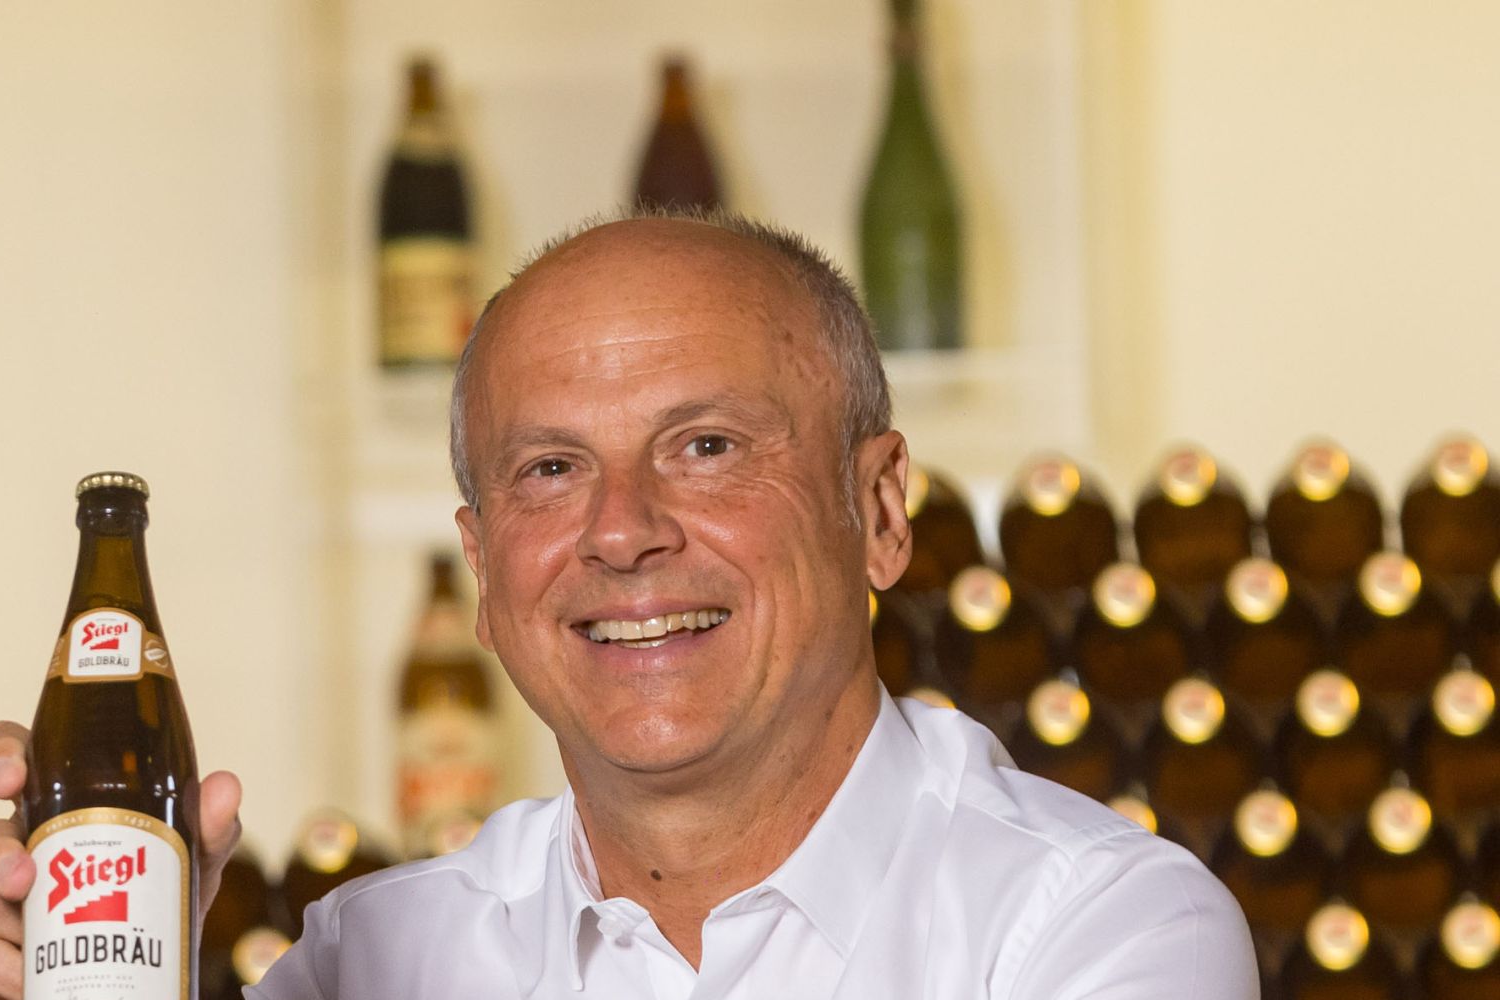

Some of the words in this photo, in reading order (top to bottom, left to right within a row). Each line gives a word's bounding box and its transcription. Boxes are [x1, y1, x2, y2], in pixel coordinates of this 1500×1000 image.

[81, 621, 129, 647] Stiegl
[78, 655, 130, 668] GOLDBRÄU
[48, 846, 146, 914] Stiegl
[35, 927, 162, 975] GOLDBRÄU
